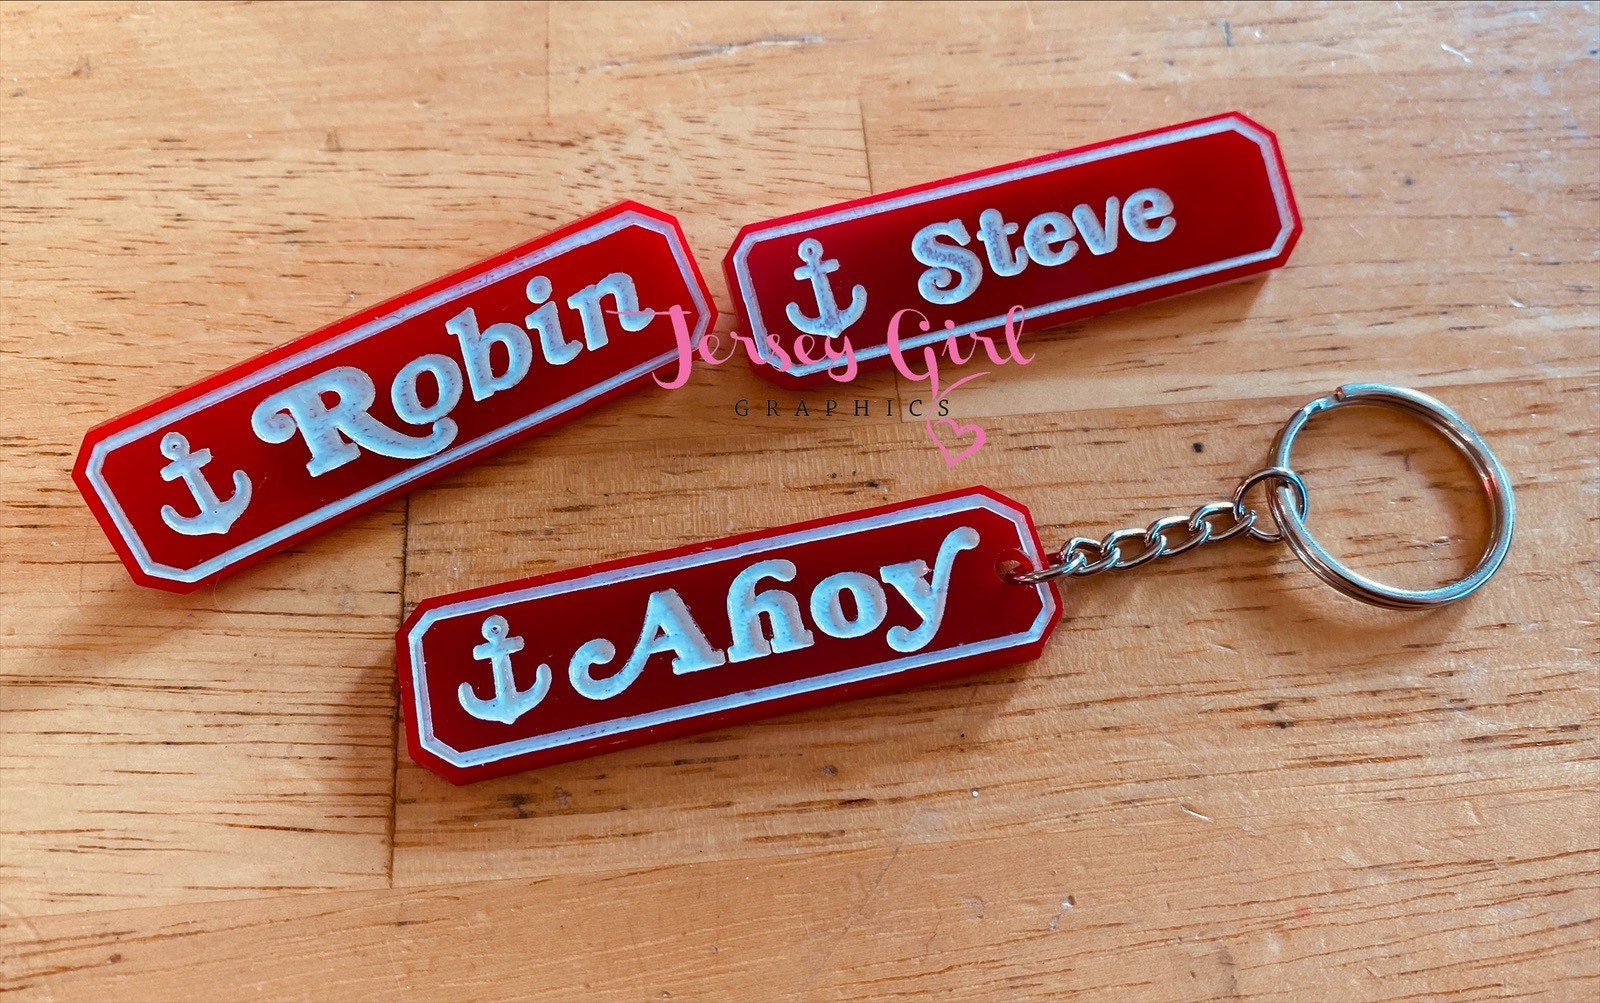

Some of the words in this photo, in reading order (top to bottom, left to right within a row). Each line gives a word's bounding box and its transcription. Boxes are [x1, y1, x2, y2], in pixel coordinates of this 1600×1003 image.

[911, 187, 1177, 305] Steve
[251, 271, 655, 478] Robin
[569, 526, 981, 700] Ahoy
